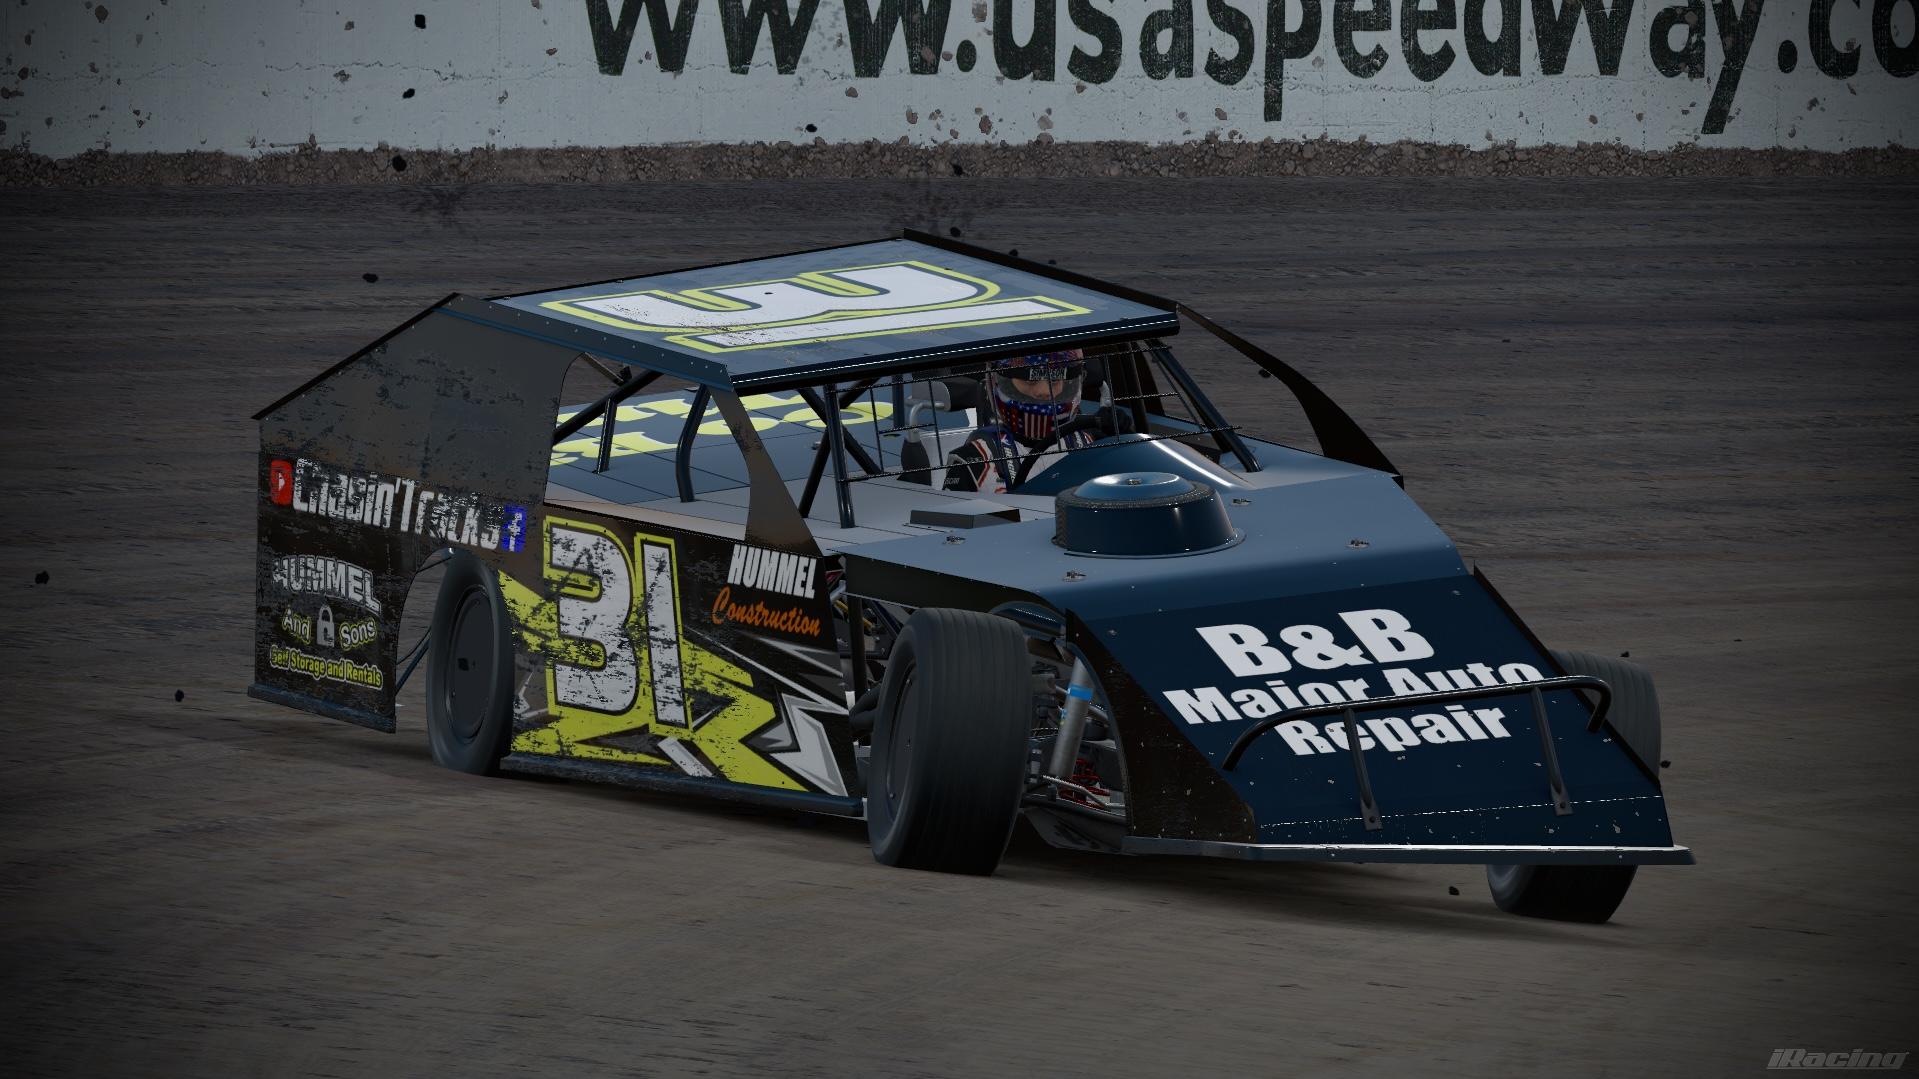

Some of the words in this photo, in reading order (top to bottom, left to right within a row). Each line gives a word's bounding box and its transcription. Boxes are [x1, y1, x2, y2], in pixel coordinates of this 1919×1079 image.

[273, 555, 382, 617] HUMMEL
[727, 544, 816, 599] HUMMEL
[283, 609, 312, 643] And
[339, 619, 377, 649] Sons
[546, 518, 693, 733] 31
[711, 586, 821, 637] Construction
[290, 650, 327, 679] Storage
[327, 662, 346, 679] and
[346, 661, 384, 689] Rentals
[1196, 608, 1435, 677] B&B
[1162, 677, 1370, 725] Major
[1382, 662, 1545, 698] Auto
[1274, 705, 1511, 755] Repair
